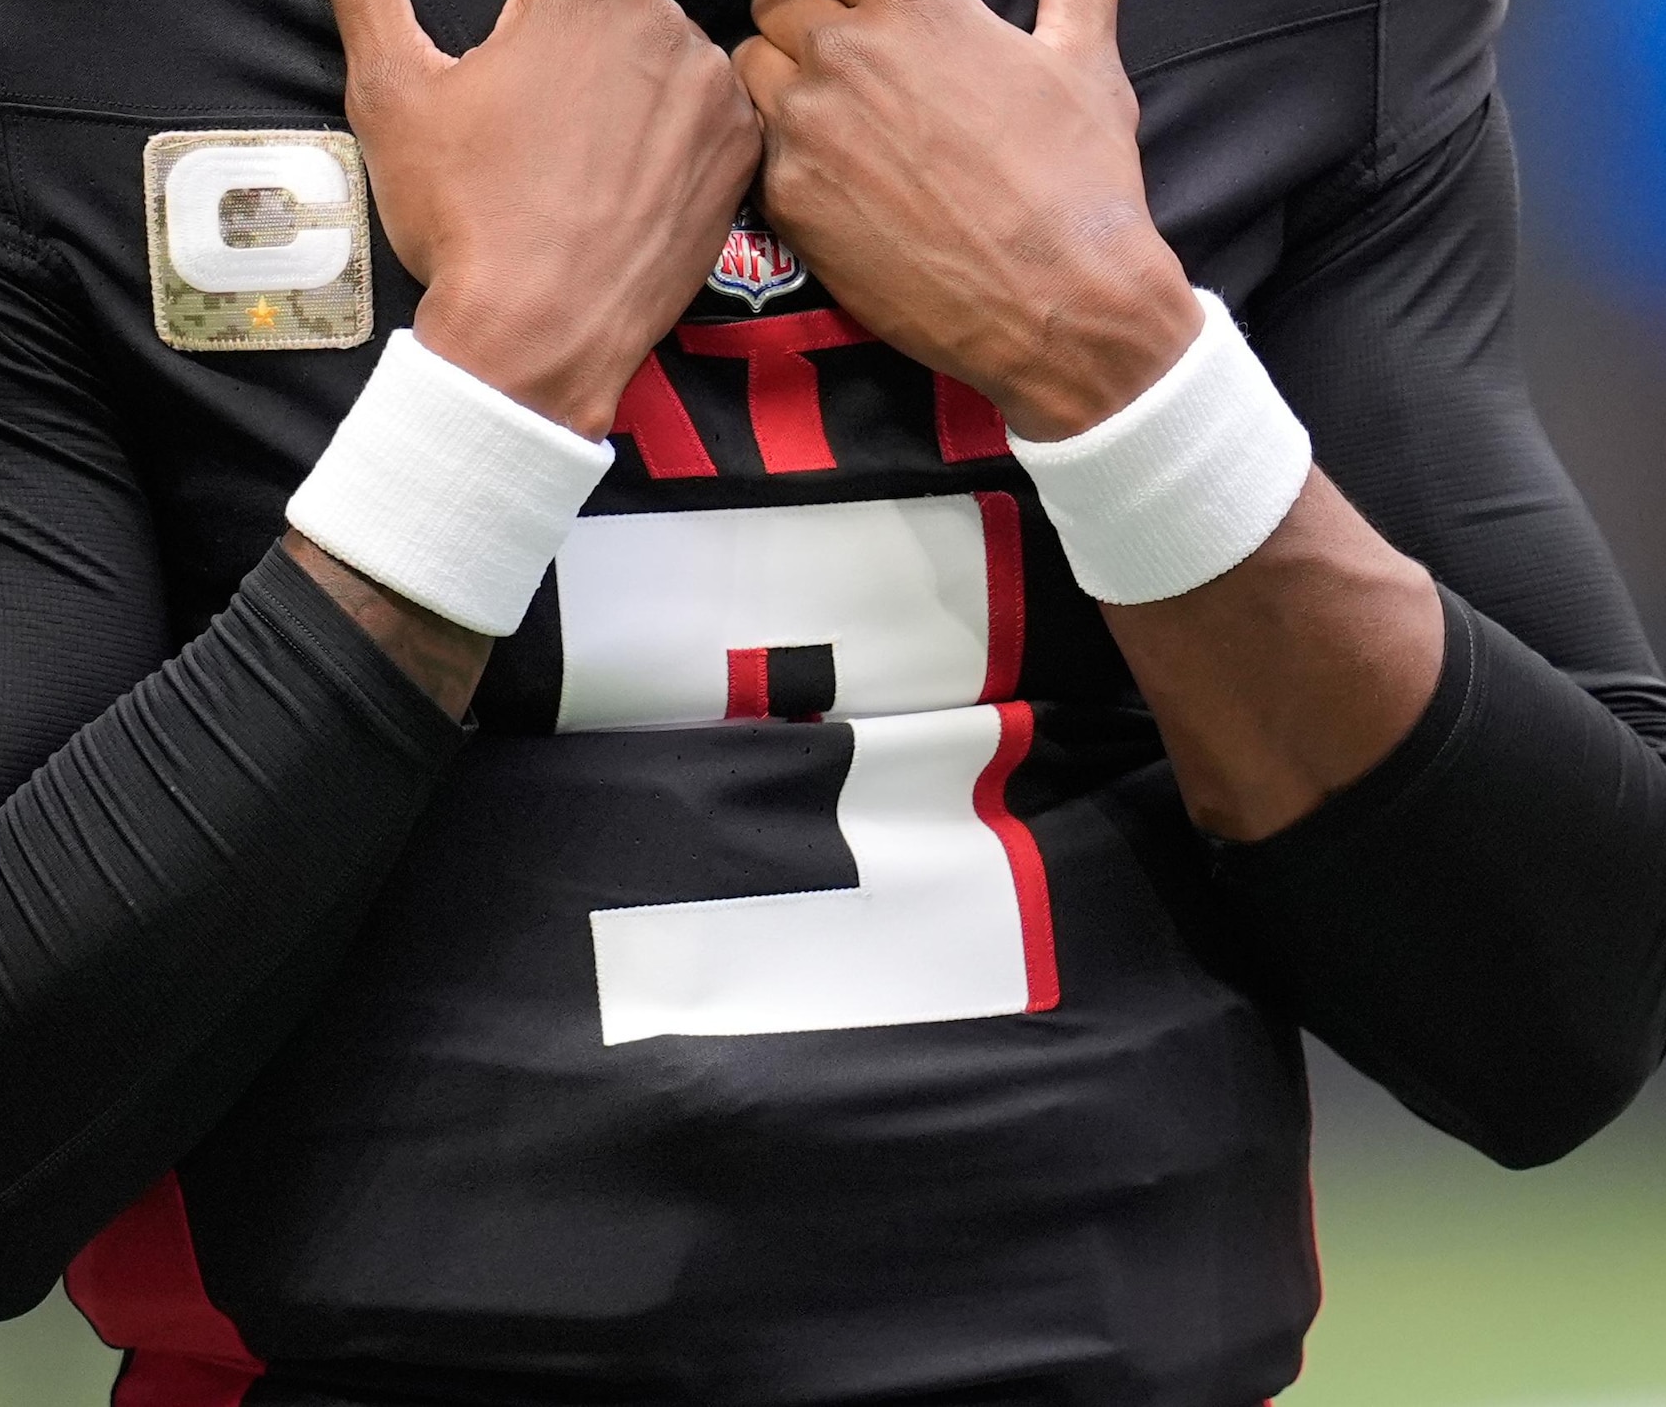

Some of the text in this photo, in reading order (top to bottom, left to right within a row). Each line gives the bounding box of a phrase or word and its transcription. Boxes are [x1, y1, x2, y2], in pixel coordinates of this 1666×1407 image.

[165, 145, 353, 294] C
[720, 231, 793, 284] NFL
[554, 490, 1061, 1046] 9
